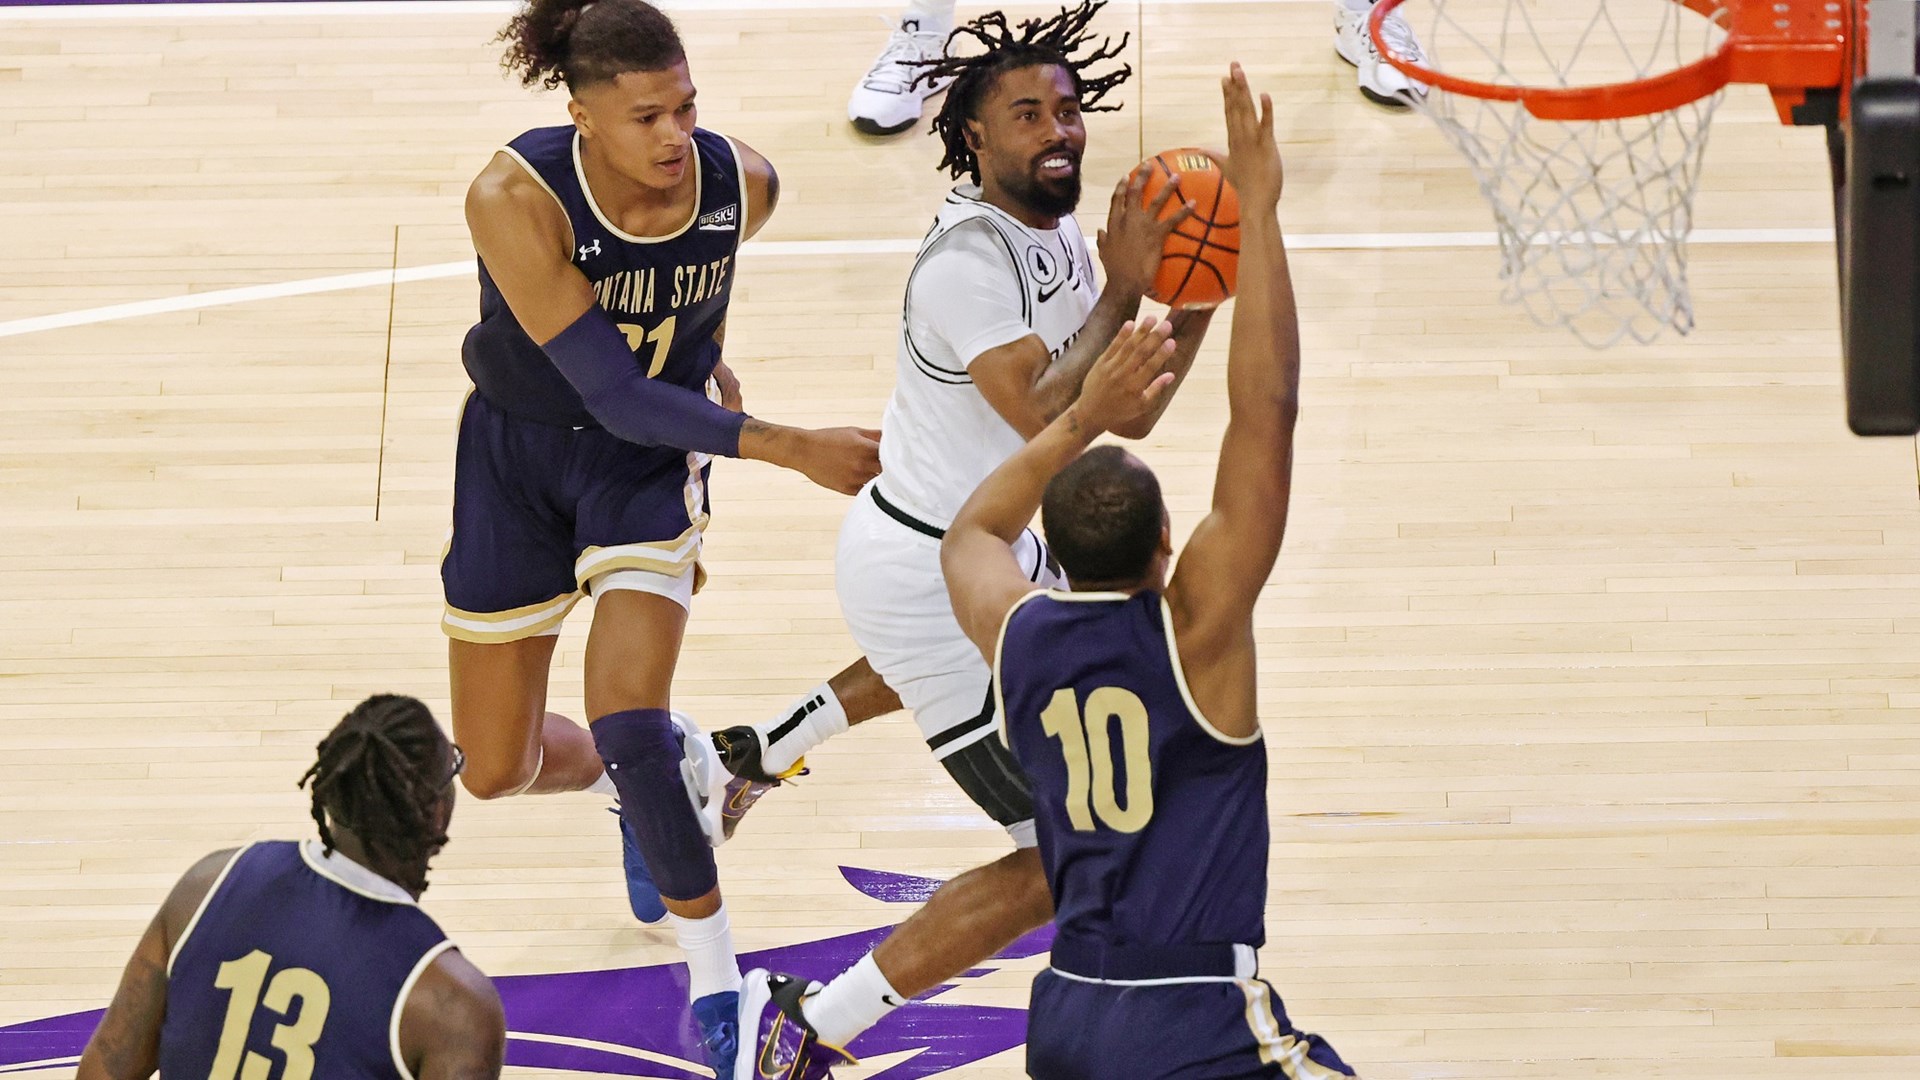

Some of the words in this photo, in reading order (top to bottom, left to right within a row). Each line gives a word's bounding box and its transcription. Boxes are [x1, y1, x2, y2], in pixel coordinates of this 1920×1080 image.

[590, 267, 655, 314] ONTANA
[671, 256, 730, 309] STATE
[1036, 252, 1050, 276] 4
[1040, 686, 1154, 833] 10
[207, 949, 331, 1080] 13
